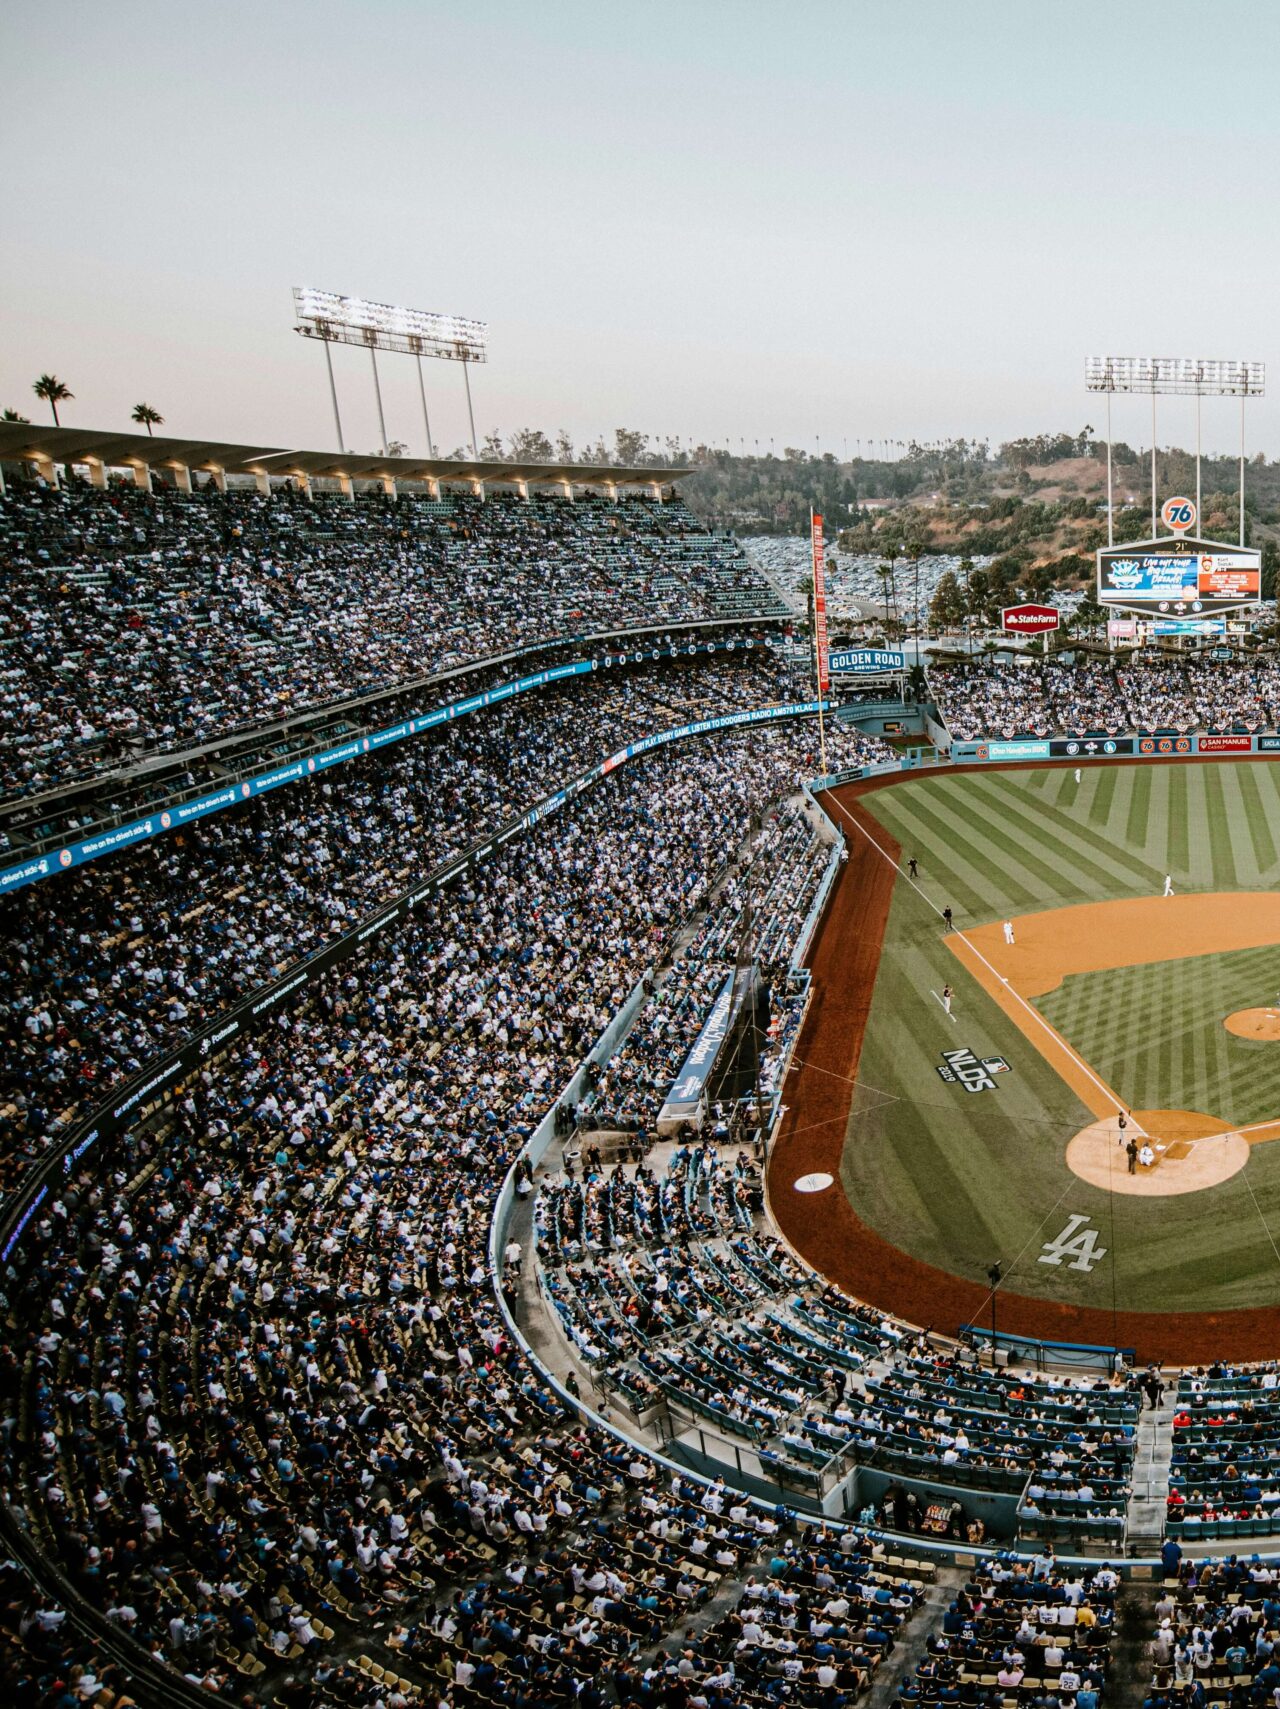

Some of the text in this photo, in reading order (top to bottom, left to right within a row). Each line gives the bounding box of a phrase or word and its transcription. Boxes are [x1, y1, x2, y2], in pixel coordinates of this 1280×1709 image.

[1168, 504, 1192, 524] 76
[820, 646, 829, 683] Emirates
[832, 652, 901, 669] GOLDEN ROAD
[691, 722, 711, 735] LISTEN
[711, 721, 720, 729] TO
[721, 714, 750, 728] DODGERS
[751, 709, 771, 720] RADIO
[773, 706, 794, 717] AM570
[795, 703, 813, 714] KLAC
[1143, 742, 1153, 750] 76
[1161, 742, 1171, 750] 76
[1178, 741, 1187, 749] 76
[82, 842, 98, 854] We're
[106, 835, 115, 845] the
[115, 829, 133, 842] driver's
[211, 1021, 239, 1044] Postmates
[938, 1066, 956, 1082] 2019
[942, 1048, 996, 1092] NLDS
[1038, 1214, 1107, 1273] LA
